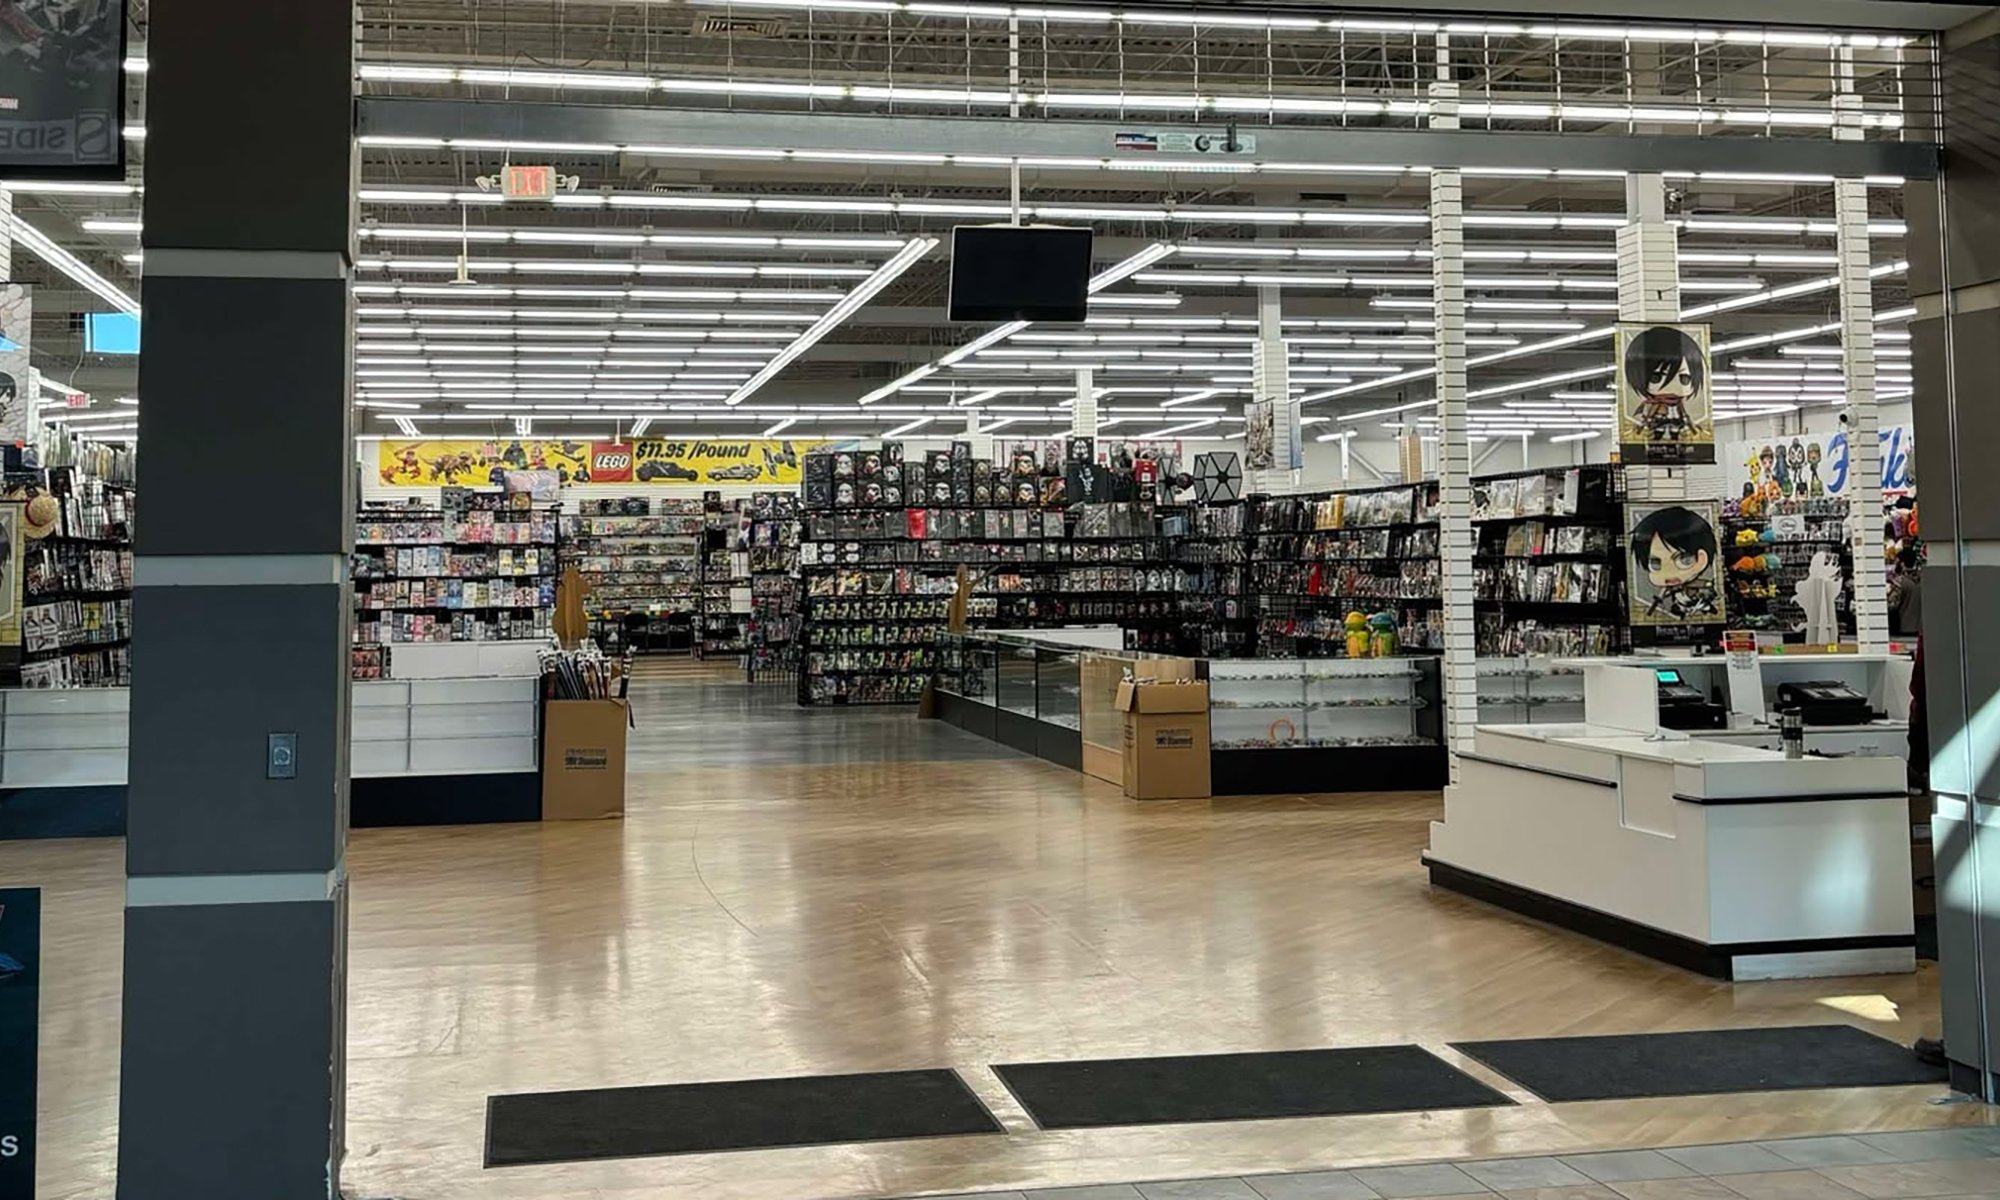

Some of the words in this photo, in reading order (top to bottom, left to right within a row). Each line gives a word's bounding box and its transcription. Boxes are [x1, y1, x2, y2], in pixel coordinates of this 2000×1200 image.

[636, 441, 688, 460] $11.95
[688, 440, 751, 460] /Pound
[594, 453, 630, 470] LEGO
